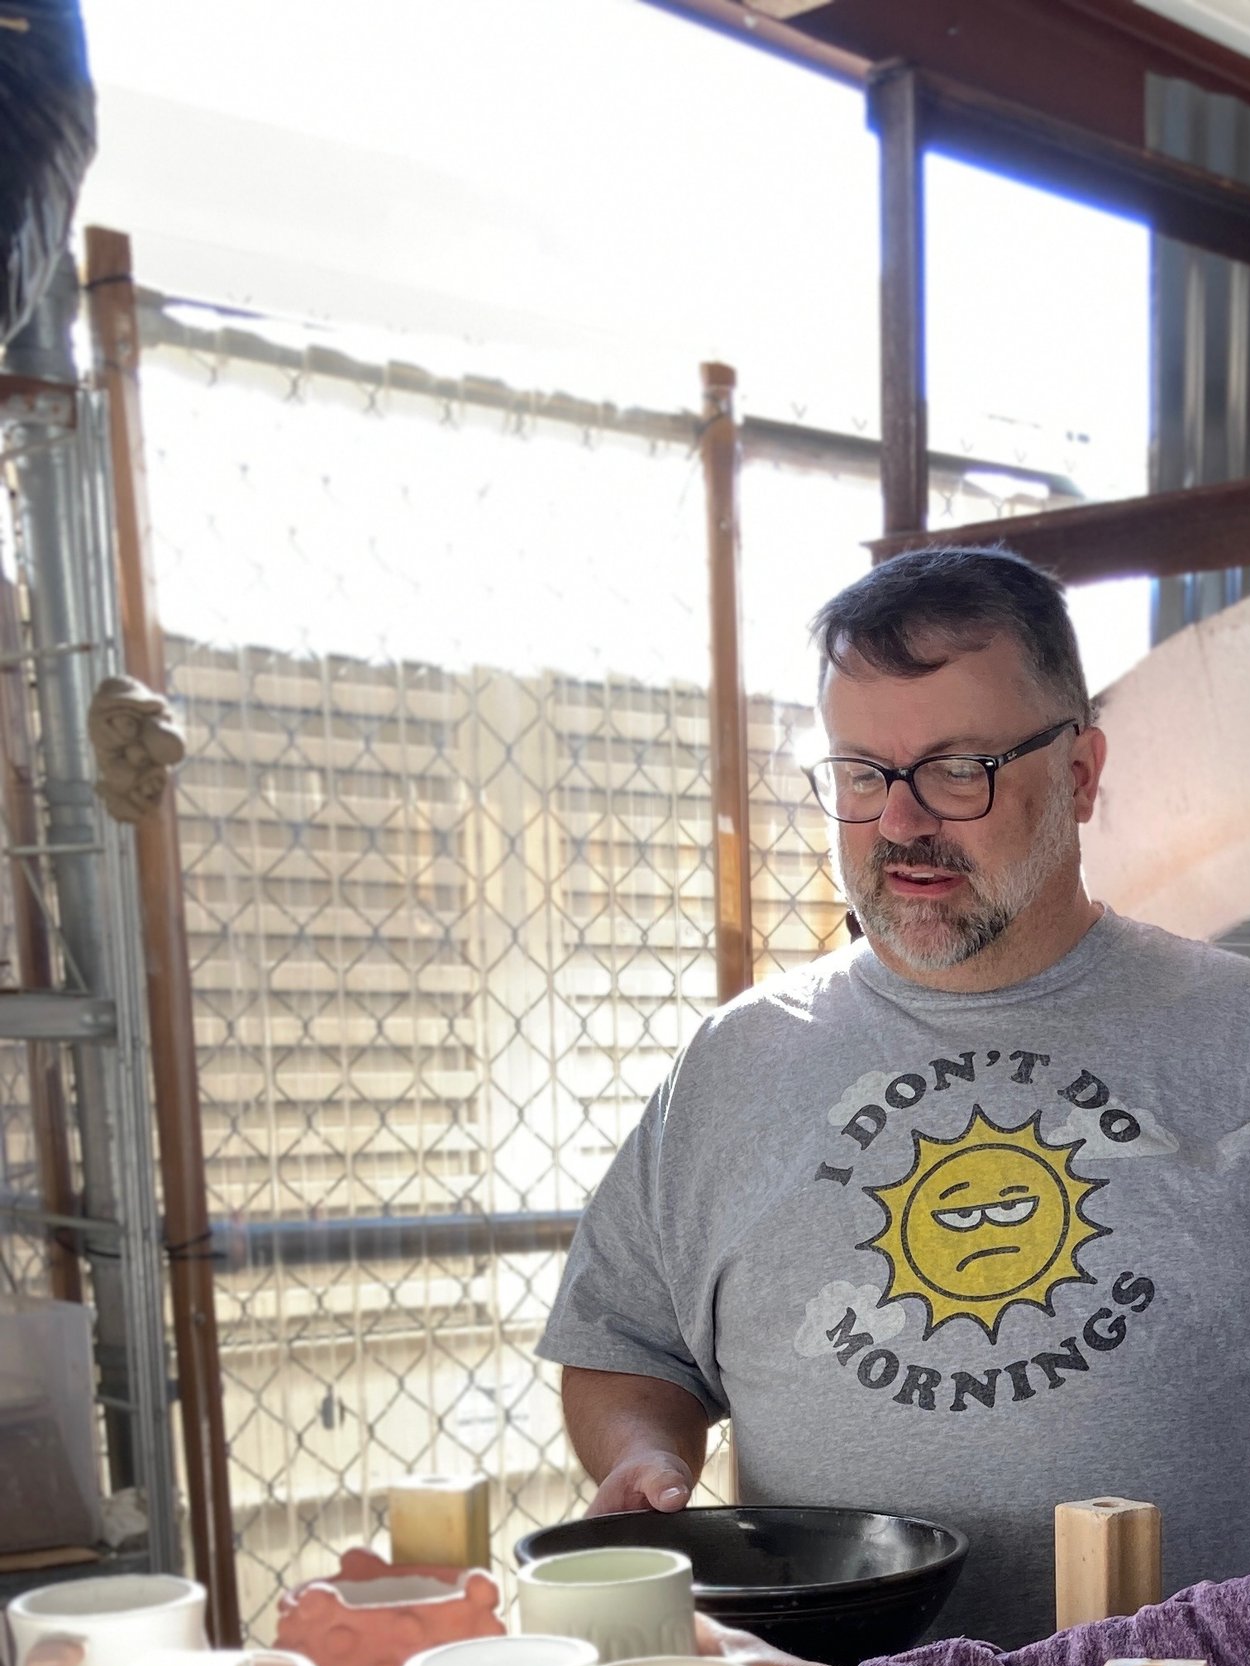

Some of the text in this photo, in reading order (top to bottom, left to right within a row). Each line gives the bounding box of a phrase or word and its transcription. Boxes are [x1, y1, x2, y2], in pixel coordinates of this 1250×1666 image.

[814, 1050, 1141, 1186] I DON'T DO
[826, 1271, 1155, 1411] MORNINGS
